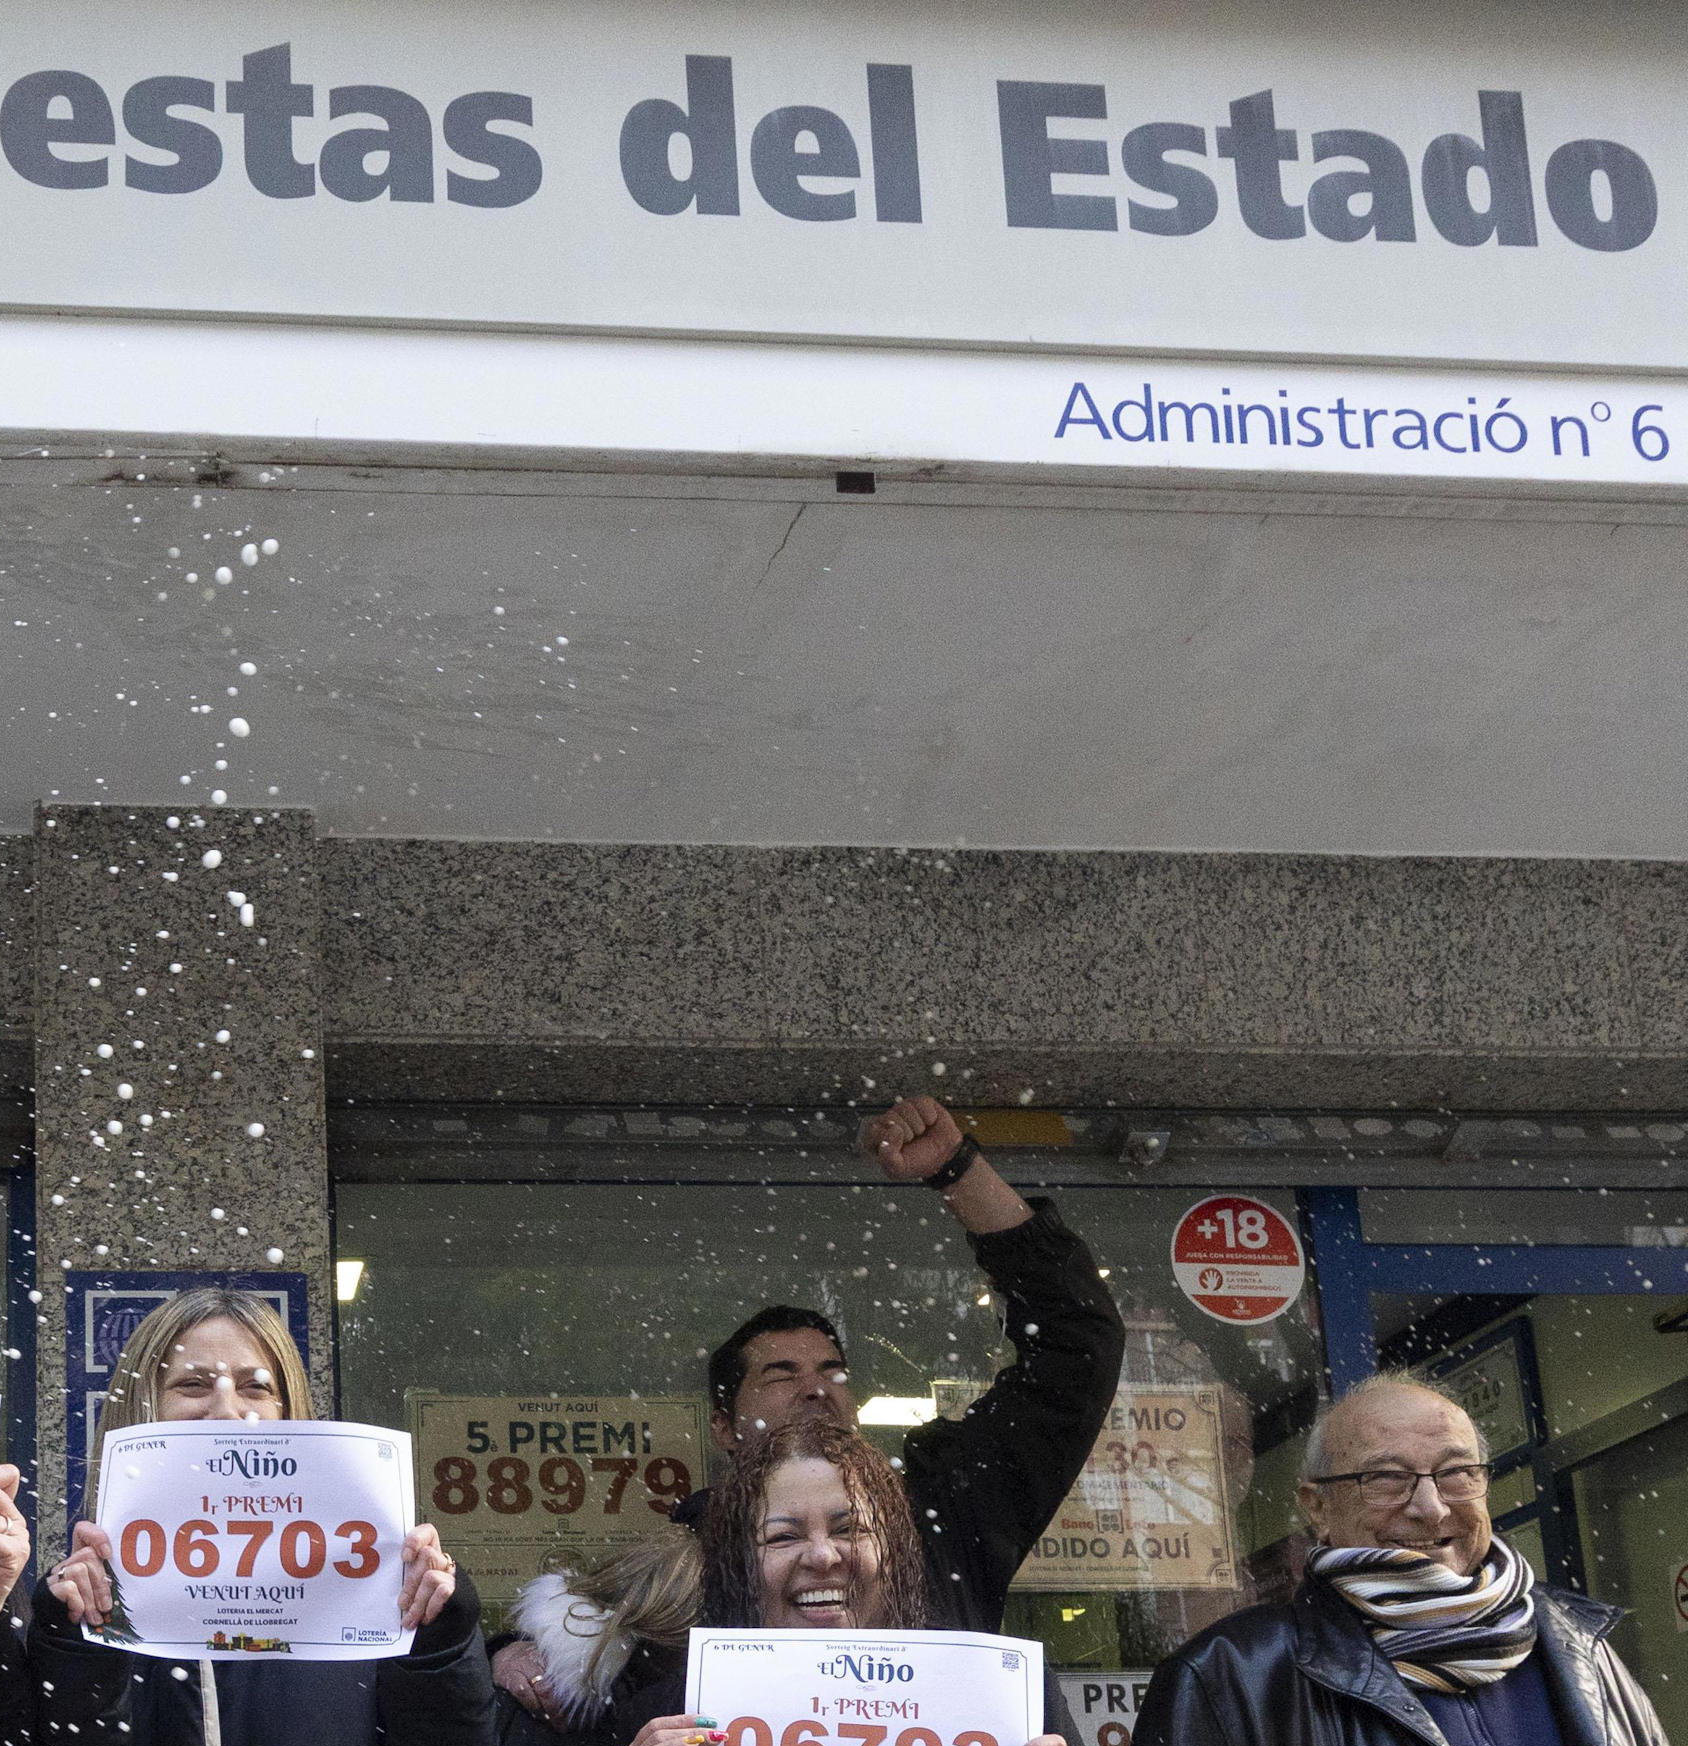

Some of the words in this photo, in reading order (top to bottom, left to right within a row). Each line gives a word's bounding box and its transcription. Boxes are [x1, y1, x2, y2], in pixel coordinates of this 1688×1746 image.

[619, 54, 922, 224] del
[996, 80, 1658, 252] Estado
[1054, 381, 1528, 454] Administració
[1631, 404, 1670, 462] 6
[1197, 1208, 1269, 1249] +18
[517, 1402, 561, 1412] VENUT
[1102, 1407, 1185, 1431] EMIO
[135, 1440, 167, 1450] GENER
[509, 1421, 651, 1454] PREMI
[205, 1458, 222, 1473] El
[222, 1449, 297, 1479] Niño
[432, 1456, 692, 1515] 88979
[223, 1493, 302, 1516] PREMI
[120, 1519, 380, 1579] 06703
[1122, 1532, 1190, 1559] AQUÍ
[184, 1584, 252, 1601] VENUT
[253, 1583, 305, 1603] AQUÍ
[244, 1618, 253, 1626] DE
[817, 1662, 834, 1675] El
[834, 1654, 914, 1683] Niño
[834, 1698, 919, 1719] PREMI
